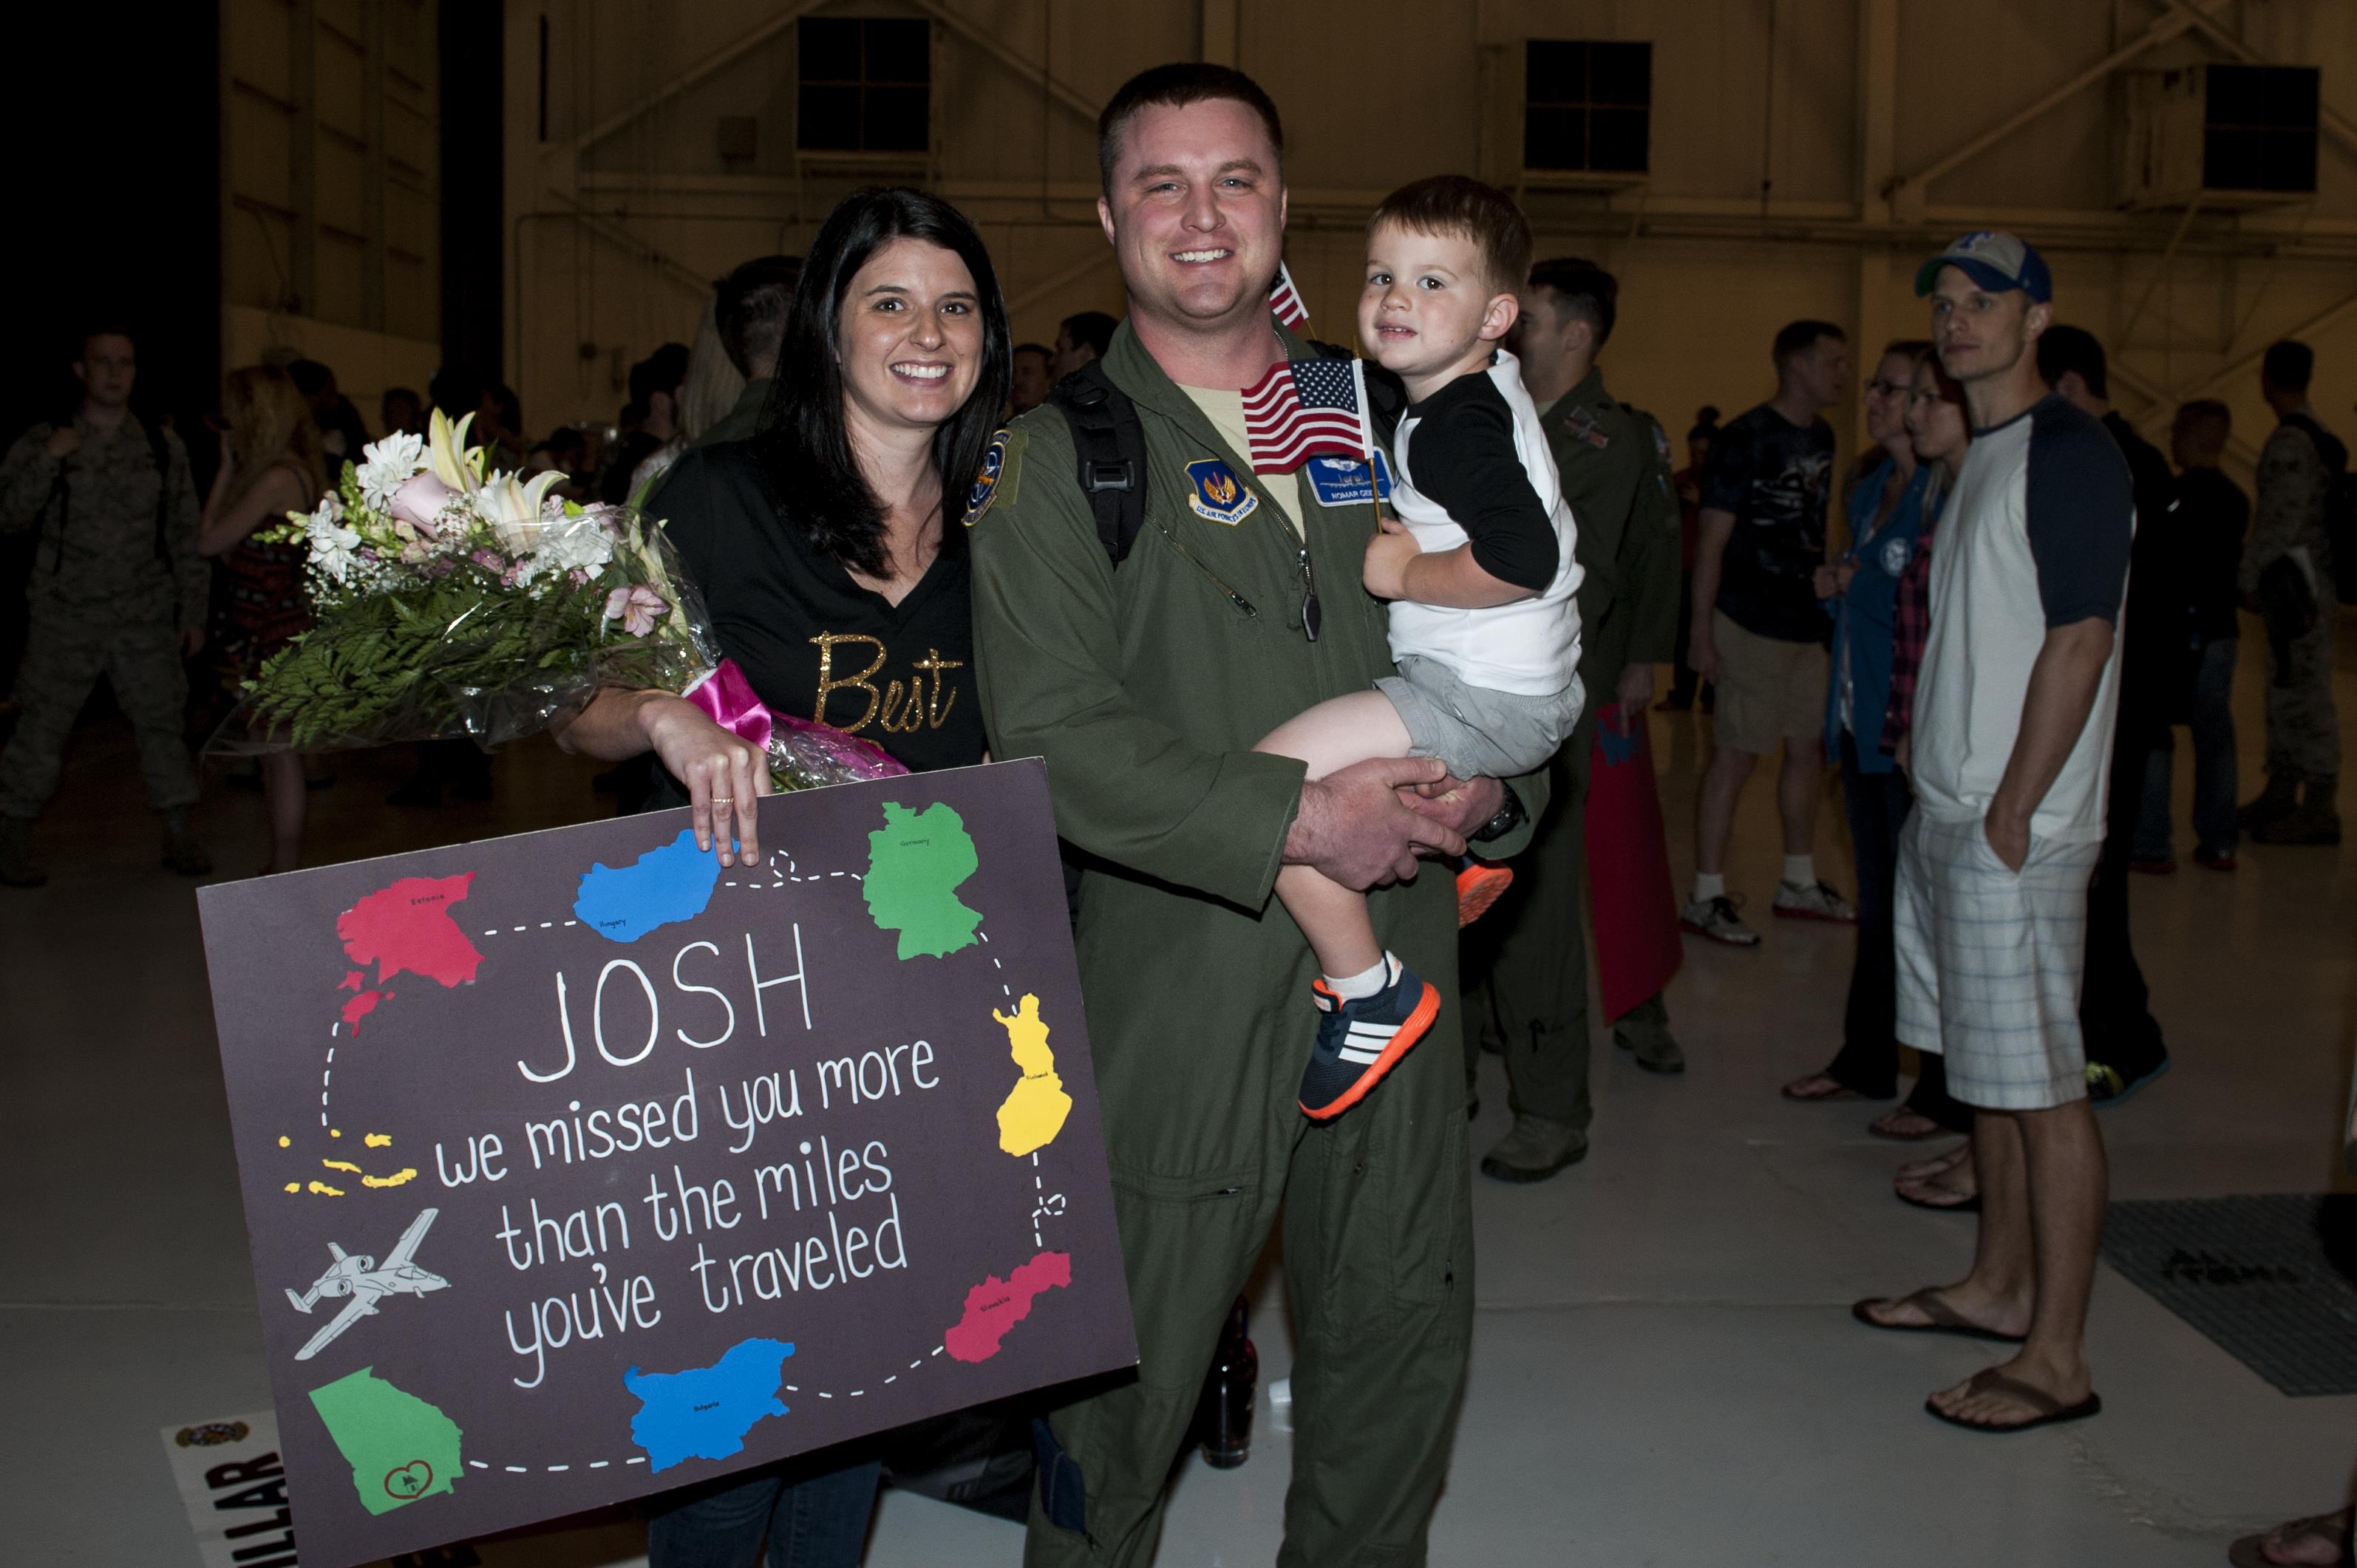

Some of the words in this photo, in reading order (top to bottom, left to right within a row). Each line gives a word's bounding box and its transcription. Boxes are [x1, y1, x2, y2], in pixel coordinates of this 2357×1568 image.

[809, 630, 963, 733] Best
[517, 922, 812, 1083] JOSH
[435, 1134, 508, 1187] we
[525, 1067, 698, 1169] missed
[719, 1069, 803, 1153] you
[816, 1040, 939, 1109] more
[495, 1198, 629, 1270] than
[643, 1165, 741, 1241] the
[754, 1135, 892, 1220] miles
[506, 1262, 661, 1388] you've
[690, 1192, 908, 1313] traveled
